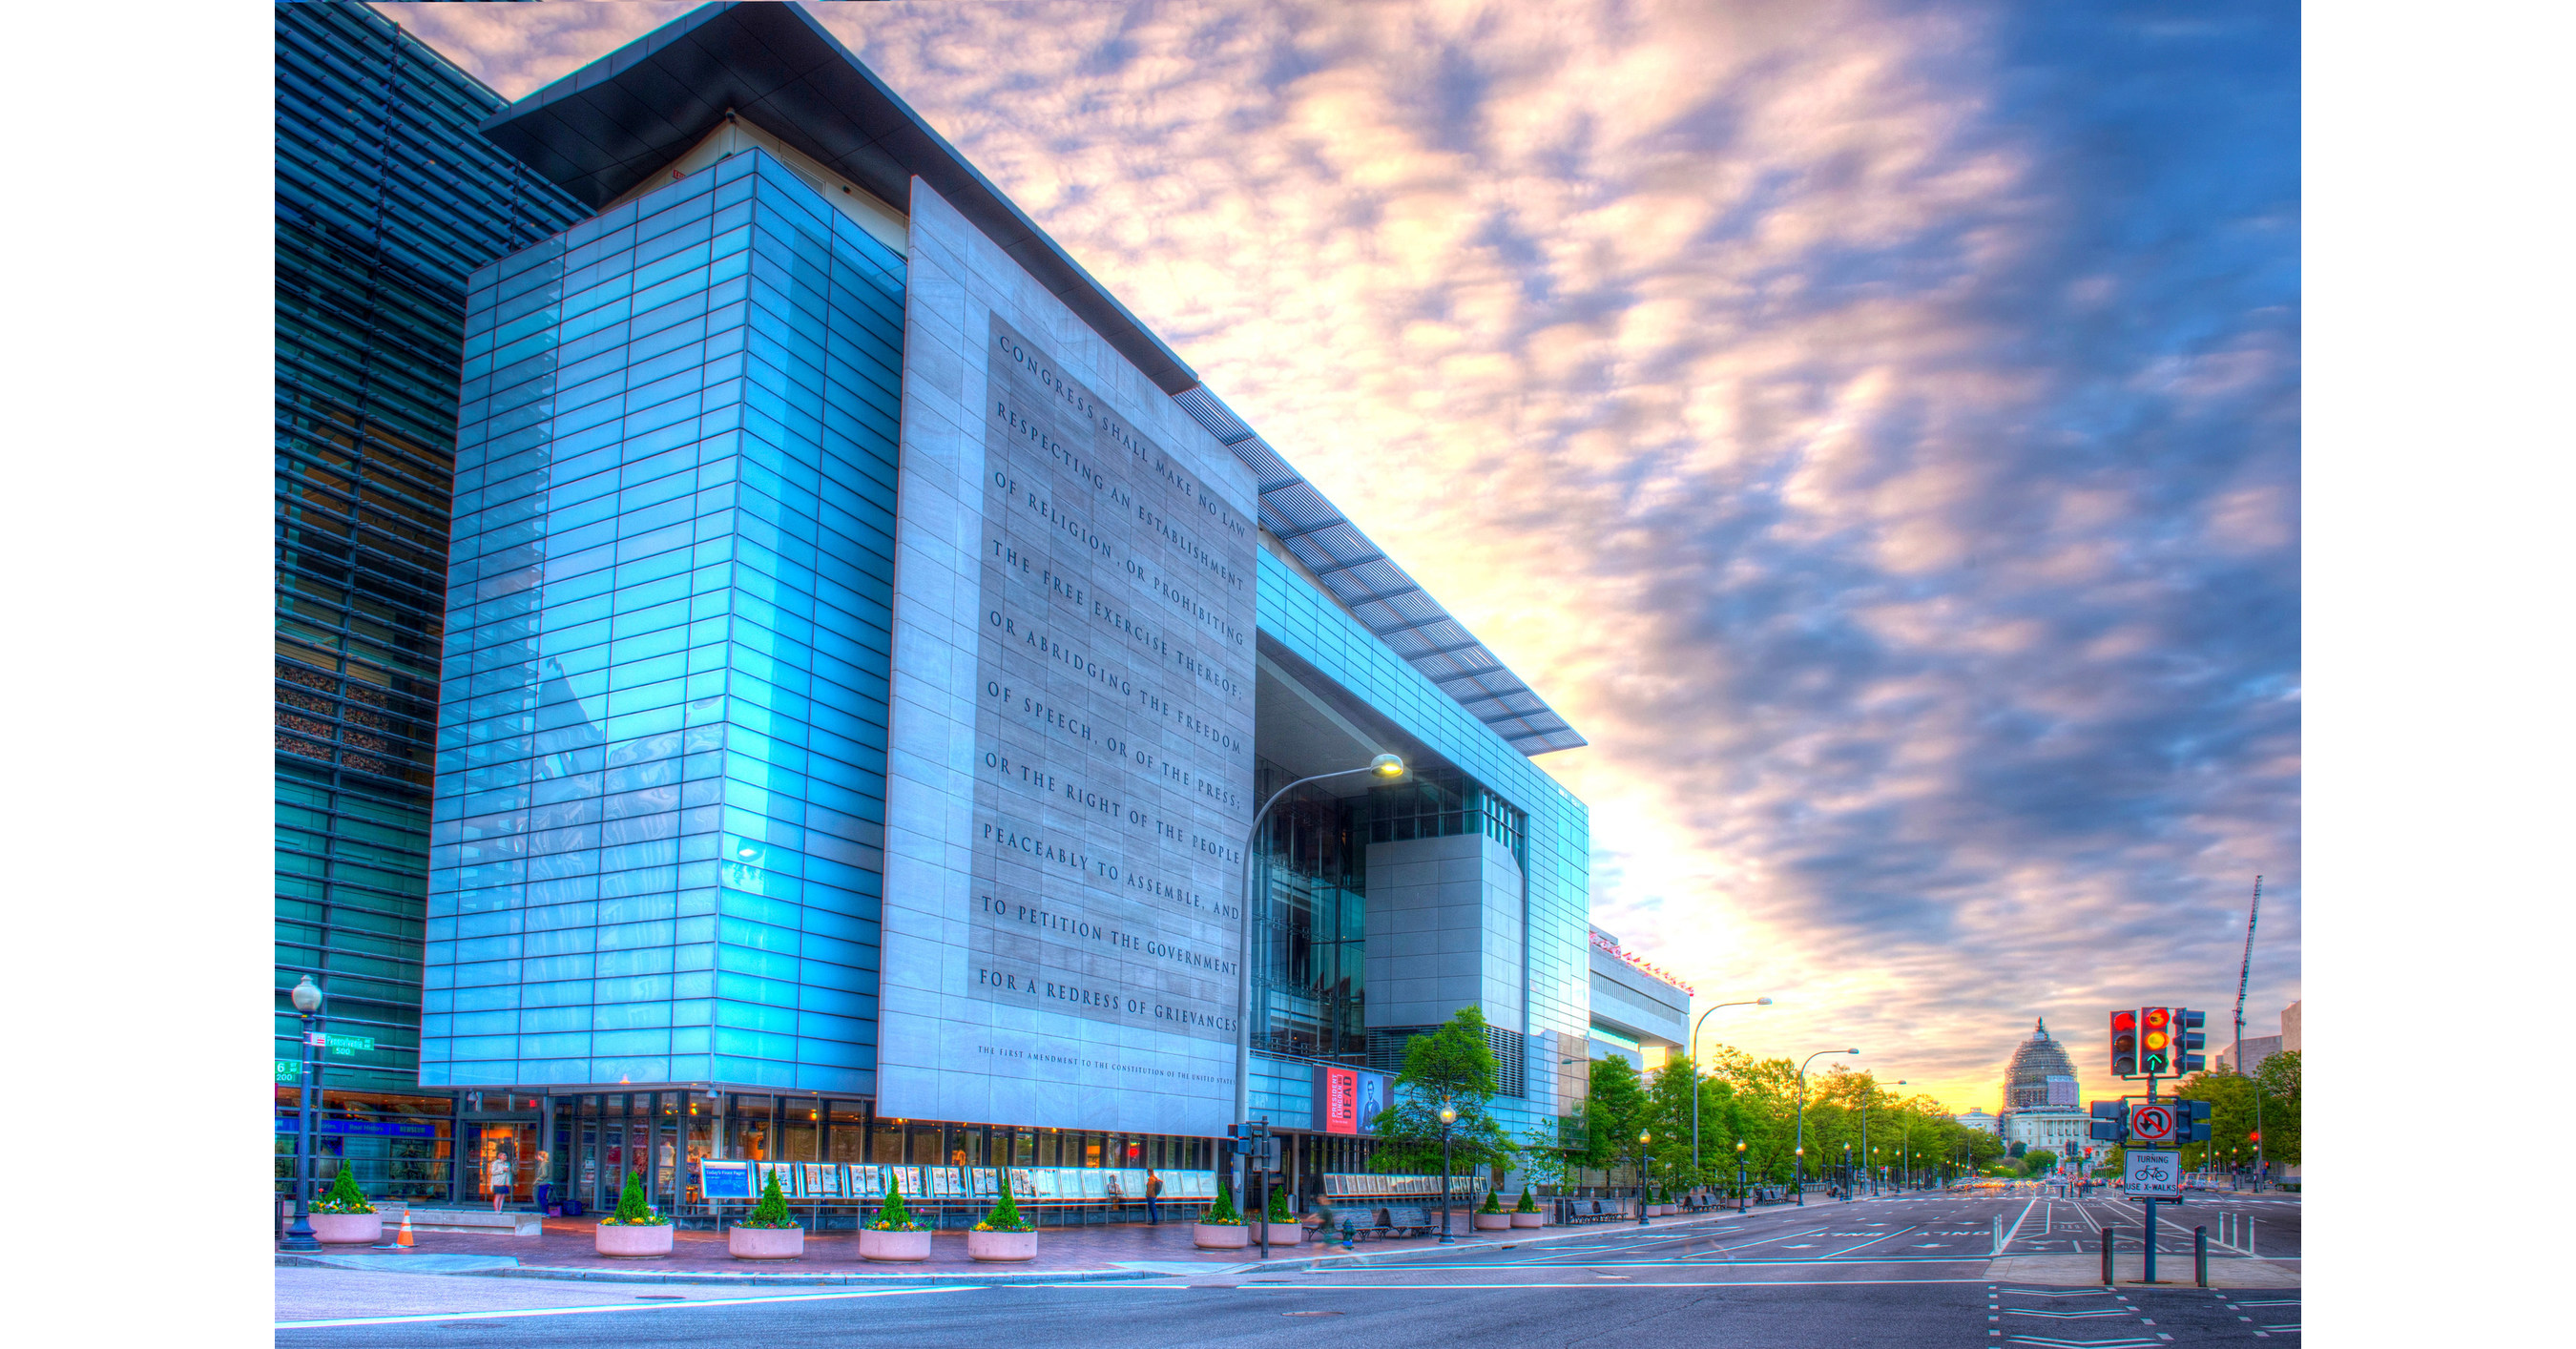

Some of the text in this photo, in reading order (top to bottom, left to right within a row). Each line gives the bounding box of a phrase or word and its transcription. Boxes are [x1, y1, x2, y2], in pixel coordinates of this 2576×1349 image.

[1000, 336, 1245, 537] CONGRESS SHALL MAKE NO LAW
[997, 402, 1243, 591] RESPECTING AN ESTABLISHMENT
[993, 539, 1029, 573] THE
[1044, 570, 1083, 605] FREE
[1094, 601, 1167, 655] EXERCISE
[995, 472, 1016, 495] OF
[1127, 560, 1145, 582] OR
[1154, 577, 1243, 645] PROHIBITING
[990, 611, 1240, 755] OR ABRIDGING THE FREEDOM
[988, 681, 1240, 810] OF SPEECH, OR OF THE PRESS;
[986, 753, 1239, 864] OR THE RIGHT OF THE PEOPLE
[984, 823, 1238, 920] PEACEABLY TO ASSEMBLE, AND
[982, 896, 1237, 976] TO PETITION THE GOVERNMENT
[326, 1035, 364, 1048] Pennsylvania
[980, 968, 1236, 1032] FOR A REDRESS OF GRIEVANCES
[277, 1063, 285, 1072] 6
[978, 1046, 994, 1055] THE
[1000, 1048, 1023, 1058] FIRST
[1028, 1052, 1078, 1066] AMENDMENT
[1095, 1061, 1109, 1069] THE
[1111, 1064, 1164, 1076] CONSTITUTION
[1193, 1074, 1215, 1083] UNITED
[1343, 1076, 1352, 1119] DEAD
